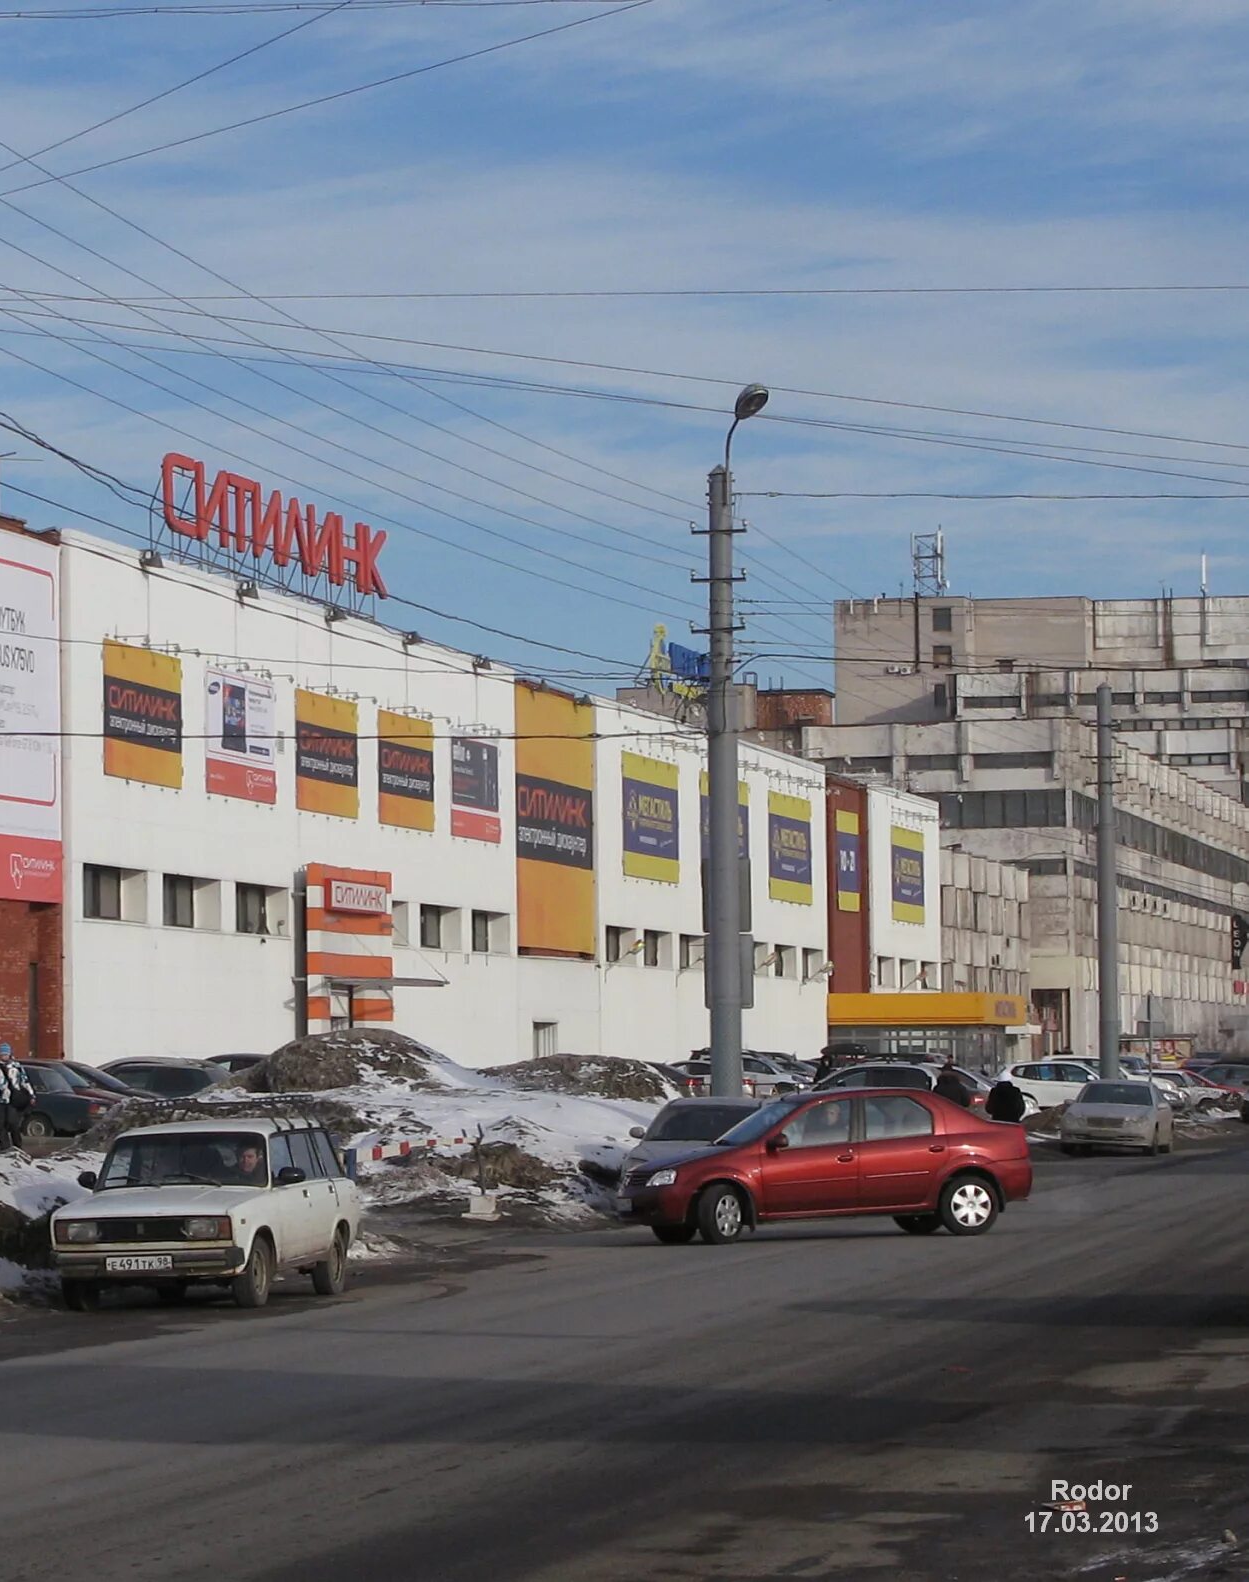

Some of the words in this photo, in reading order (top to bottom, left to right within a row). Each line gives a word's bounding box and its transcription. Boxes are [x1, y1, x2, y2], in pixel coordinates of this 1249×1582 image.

[162, 452, 387, 600] СИТИЛИНК
[109, 685, 177, 721] СИТИЛИНК
[518, 786, 587, 828] СИТИЛИНК
[334, 885, 383, 909] СИТИЛИНК
